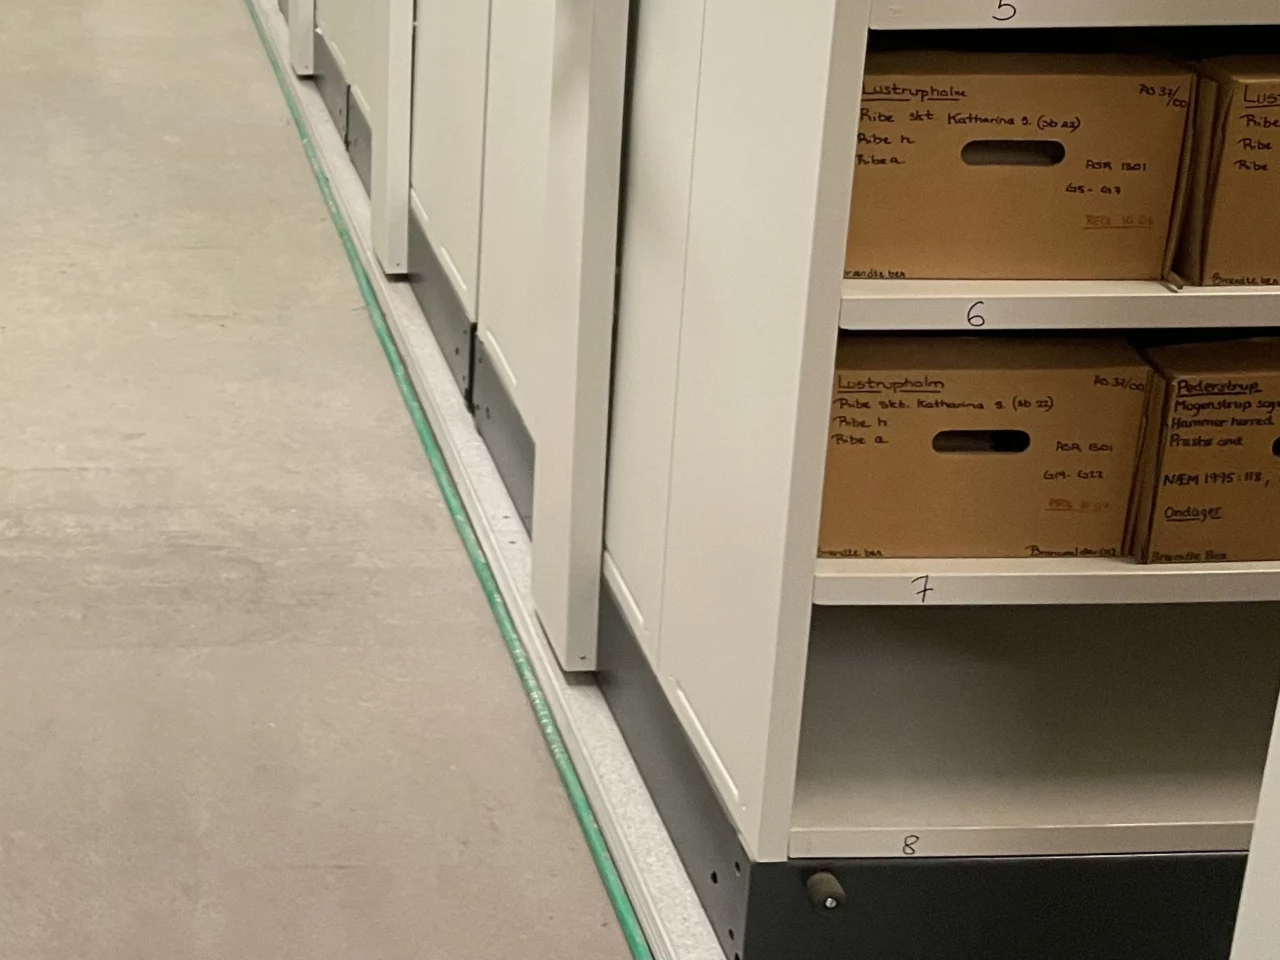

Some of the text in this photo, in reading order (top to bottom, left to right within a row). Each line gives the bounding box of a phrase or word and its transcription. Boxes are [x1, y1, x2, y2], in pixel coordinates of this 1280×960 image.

[860, 108, 895, 123] Ribe
[1239, 114, 1280, 128] Ribe
[856, 132, 891, 145] Ribe
[1236, 137, 1272, 150] Ribe
[1233, 159, 1268, 171] Ribe
[967, 301, 986, 327] 6
[911, 574, 934, 603] 7
[902, 834, 920, 855] 8
